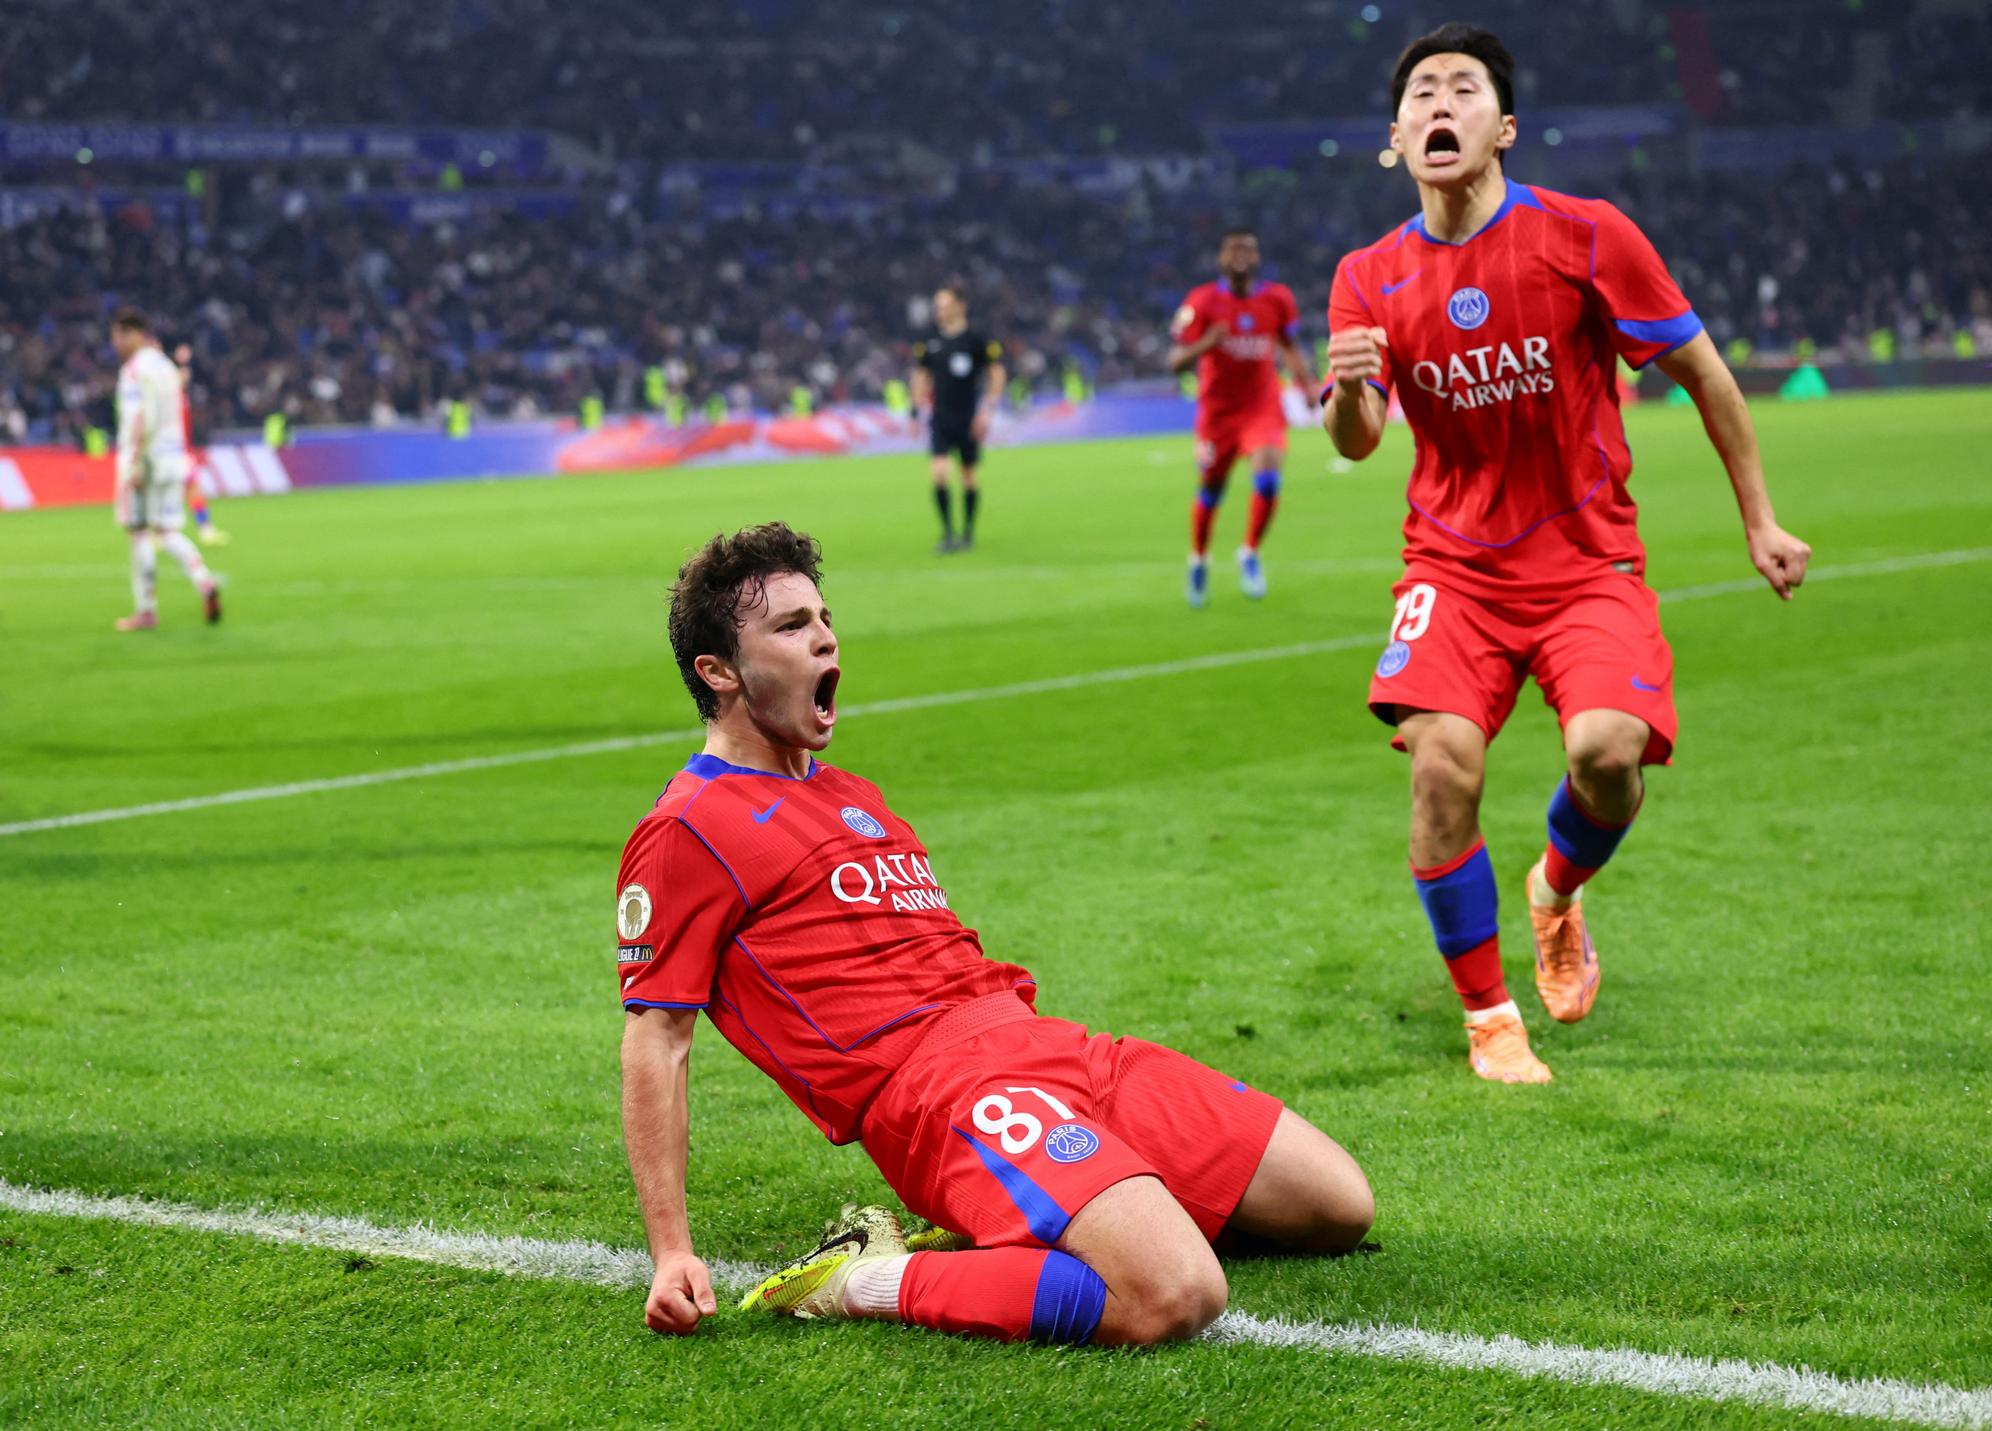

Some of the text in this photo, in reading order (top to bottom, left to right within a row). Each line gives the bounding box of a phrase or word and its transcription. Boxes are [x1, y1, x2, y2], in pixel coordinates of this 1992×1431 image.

[1412, 335, 1553, 399] QATAR
[1452, 371, 1555, 412] AIRWAYS
[1390, 583, 1437, 643] 19
[971, 1086, 1077, 1155] 87
[1047, 1126, 1077, 1145] PARIS
